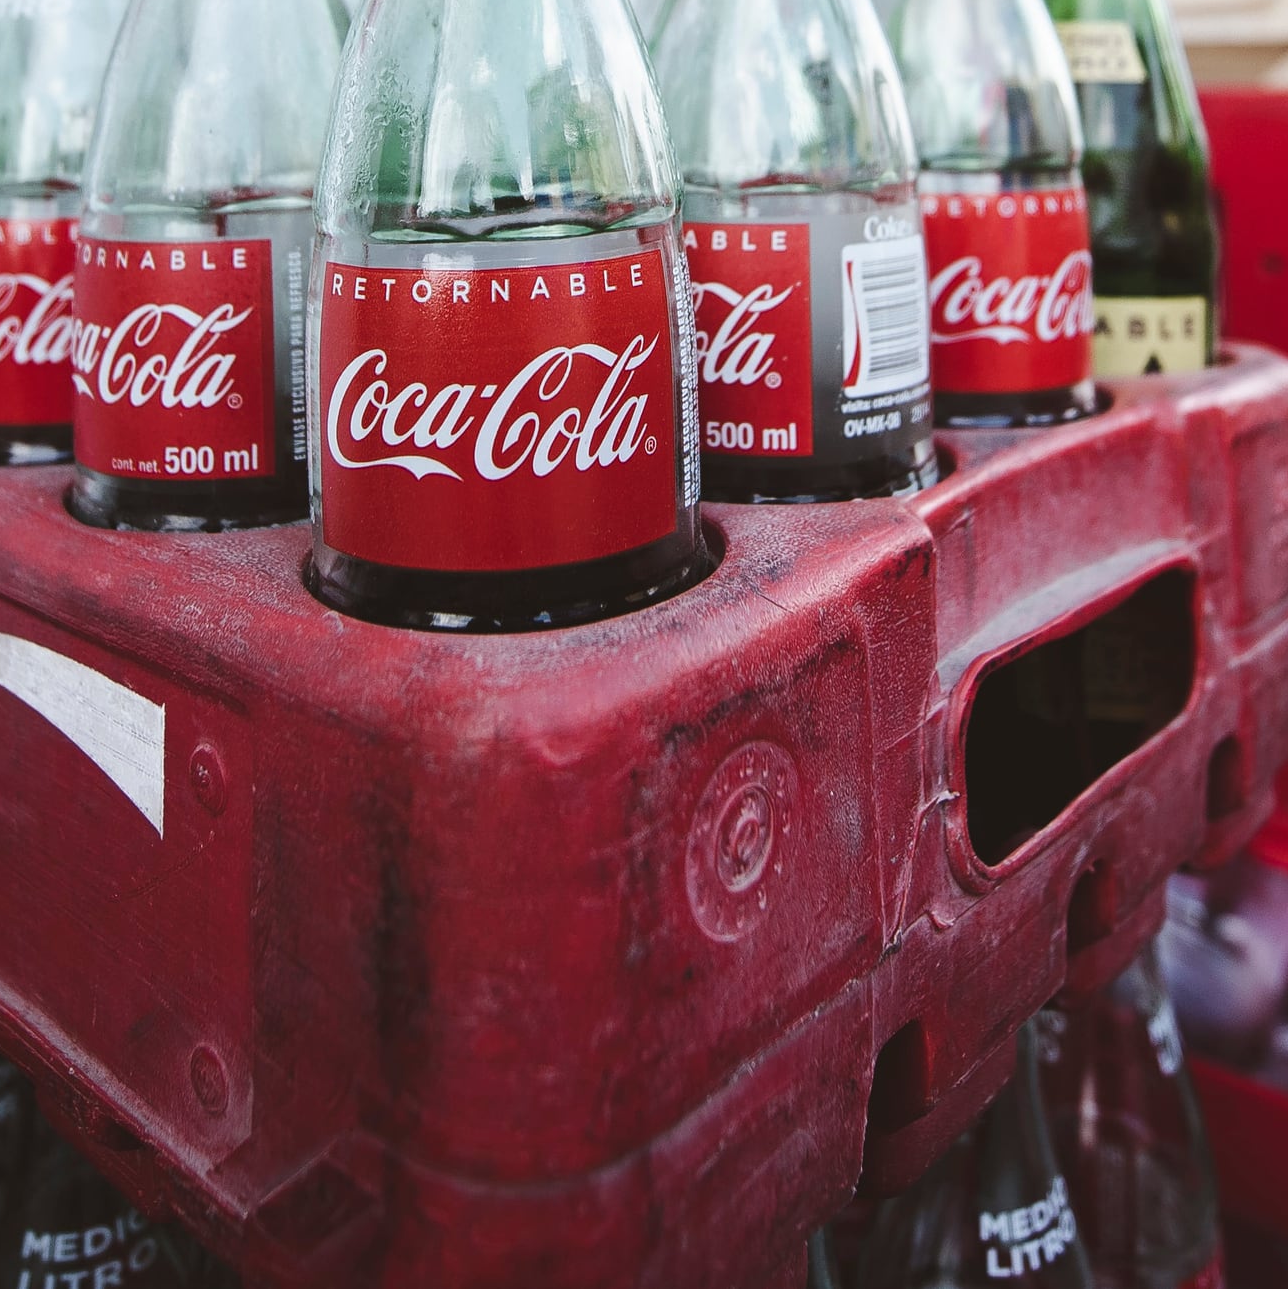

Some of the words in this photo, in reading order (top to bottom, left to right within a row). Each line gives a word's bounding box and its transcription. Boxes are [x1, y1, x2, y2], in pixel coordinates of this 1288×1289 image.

[331, 263, 644, 304] RETORNABLE
[680, 340, 689, 374] PARA
[327, 331, 661, 482] Coca-Cola
[681, 379, 691, 453] EXCLUSIVO
[706, 422, 755, 450] 500
[762, 422, 797, 450] ml
[164, 446, 215, 474] 500
[224, 443, 258, 473] ml
[684, 456, 692, 508] ENVASE
